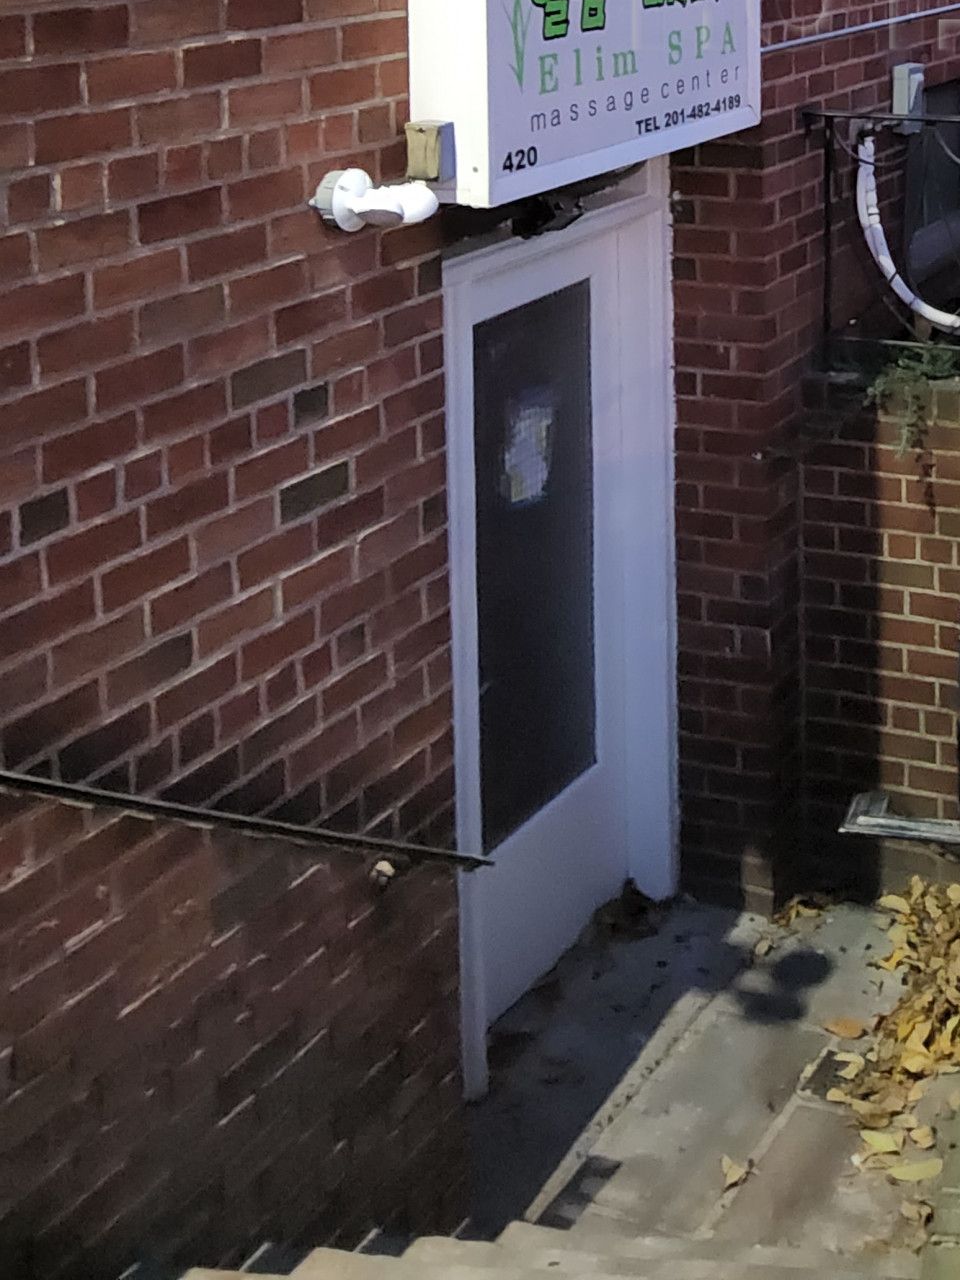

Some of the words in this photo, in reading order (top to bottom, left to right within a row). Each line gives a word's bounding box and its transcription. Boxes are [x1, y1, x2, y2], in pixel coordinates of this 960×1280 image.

[538, 46, 639, 96] Elim
[667, 21, 736, 65] SPA
[530, 86, 650, 133] massage
[660, 65, 740, 100] center
[635, 116, 661, 136] TEL
[664, 93, 741, 128] 201-482-4189
[502, 145, 538, 173] 420
